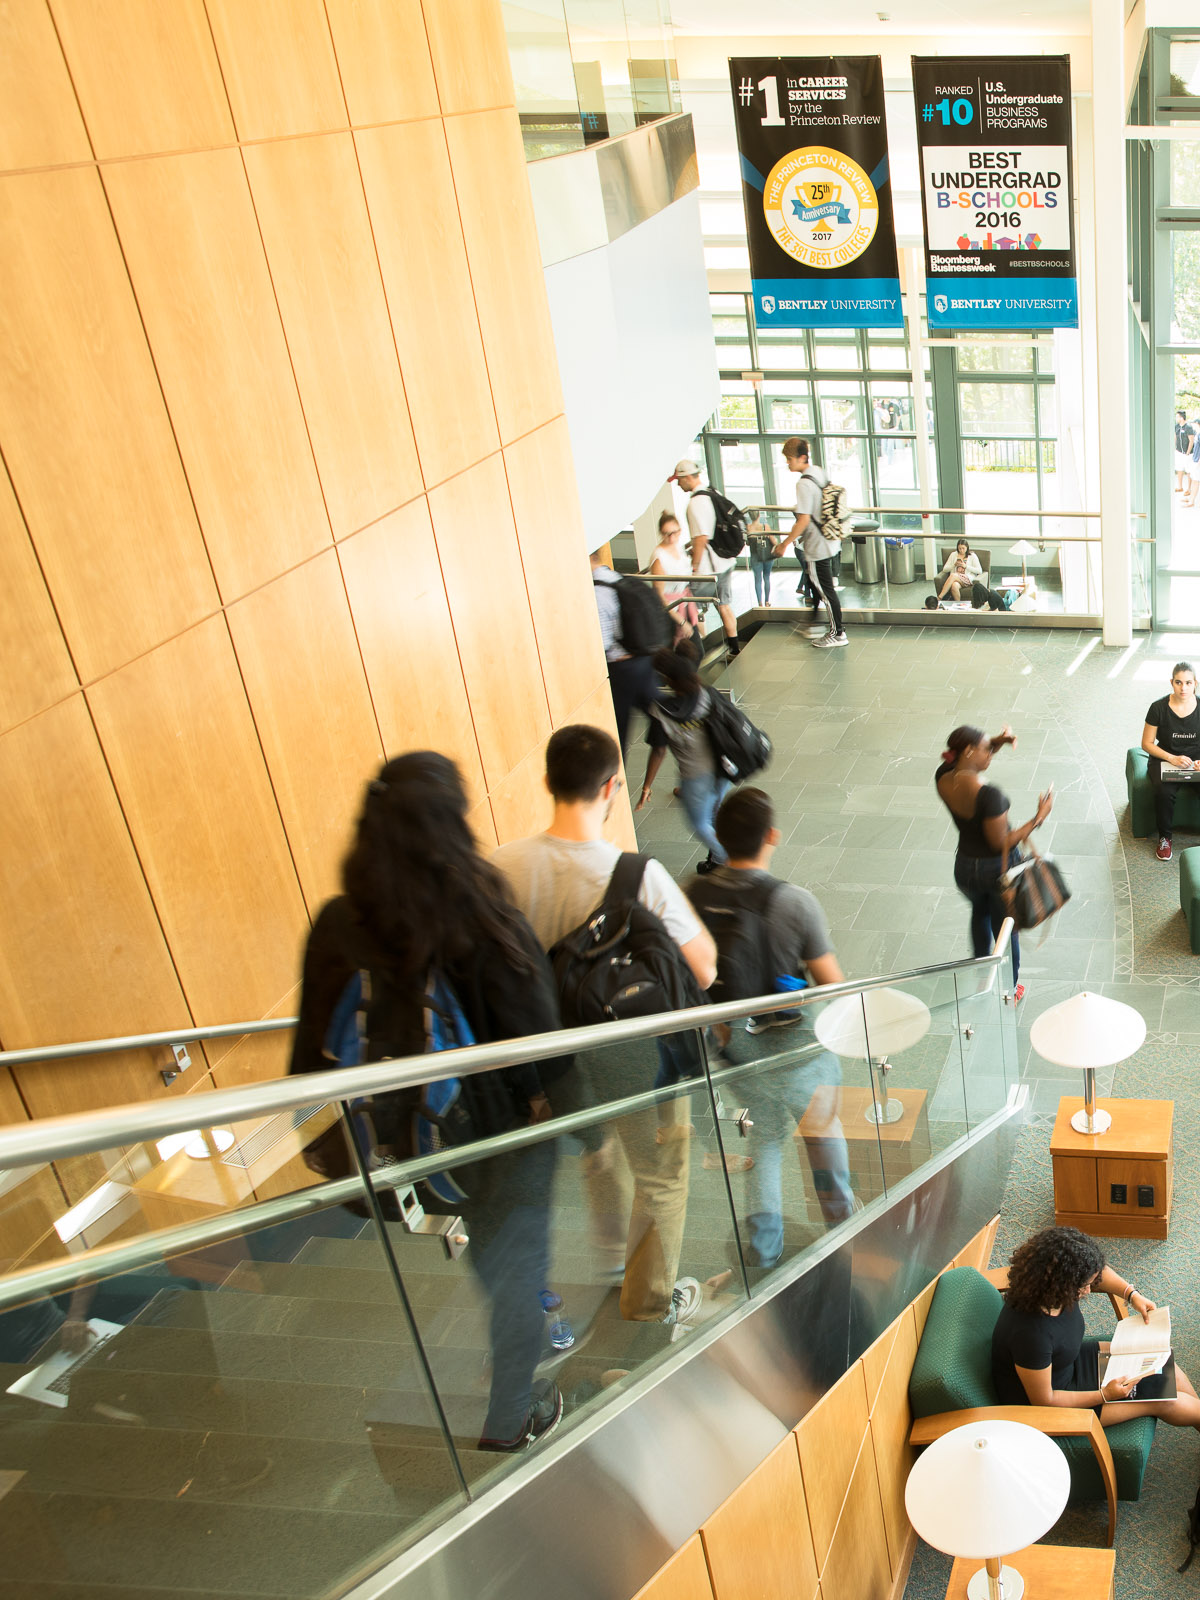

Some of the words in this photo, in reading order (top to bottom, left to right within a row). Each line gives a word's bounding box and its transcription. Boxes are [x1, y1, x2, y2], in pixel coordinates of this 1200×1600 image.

[786, 77, 798, 88] in
[798, 76, 849, 88] CAREER
[984, 81, 1007, 93] U.S.
[788, 89, 847, 101] SERVICES
[935, 86, 974, 96] RANKED
[985, 93, 1064, 106] Undergraduate
[789, 102, 803, 114] by
[804, 102, 823, 113] the
[922, 98, 974, 126] #10
[986, 106, 1039, 118] BUSINESS
[789, 115, 842, 126] Princeton
[843, 114, 881, 125] Review
[987, 118, 1048, 129] PROGRAMS
[968, 151, 1022, 169] BEST
[769, 182, 782, 205] THE
[778, 153, 839, 181] PRINCETON
[838, 161, 873, 204] REVIEW
[931, 171, 1062, 189] UNDERGRAD
[811, 183, 831, 201] 25th
[937, 191, 1058, 209] B-SCHOOLS
[801, 203, 841, 221] Anniversary
[975, 211, 1022, 228] 2016
[812, 232, 832, 241] 2017
[775, 225, 791, 248] THE
[789, 244, 809, 261] 381
[809, 253, 832, 266] BEST
[834, 225, 872, 264] COLLEGES
[930, 254, 981, 266] Bloomberg
[1009, 260, 1071, 268] #BESTBSCHOOLS
[930, 262, 997, 273] Businessweek
[778, 300, 828, 310] BENTLEY
[831, 299, 897, 310] UNIVERSITY
[950, 299, 1002, 309] BENTLEY
[1005, 299, 1073, 310] UNIVERSITY
